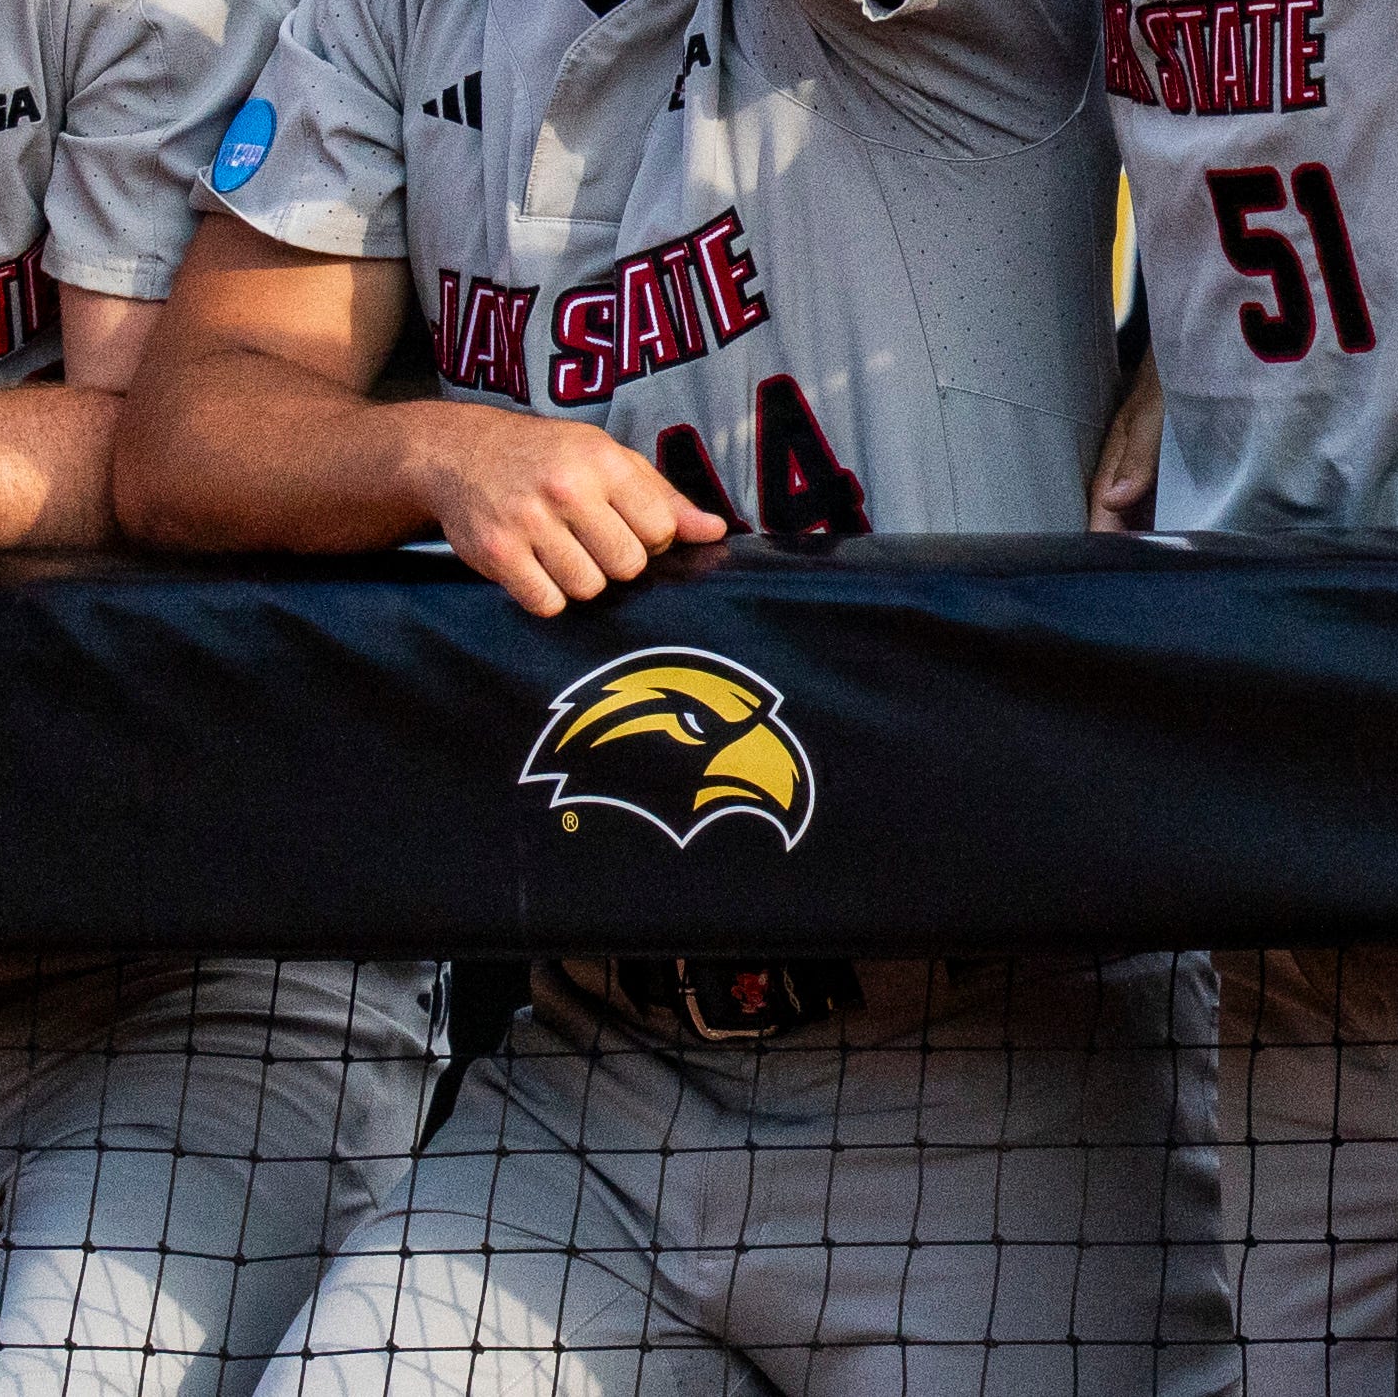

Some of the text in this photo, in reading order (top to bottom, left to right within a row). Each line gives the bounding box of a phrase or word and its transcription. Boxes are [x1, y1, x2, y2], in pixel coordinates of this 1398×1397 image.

[430, 205, 771, 406] JAX SATE
[1205, 162, 1377, 364] 51
